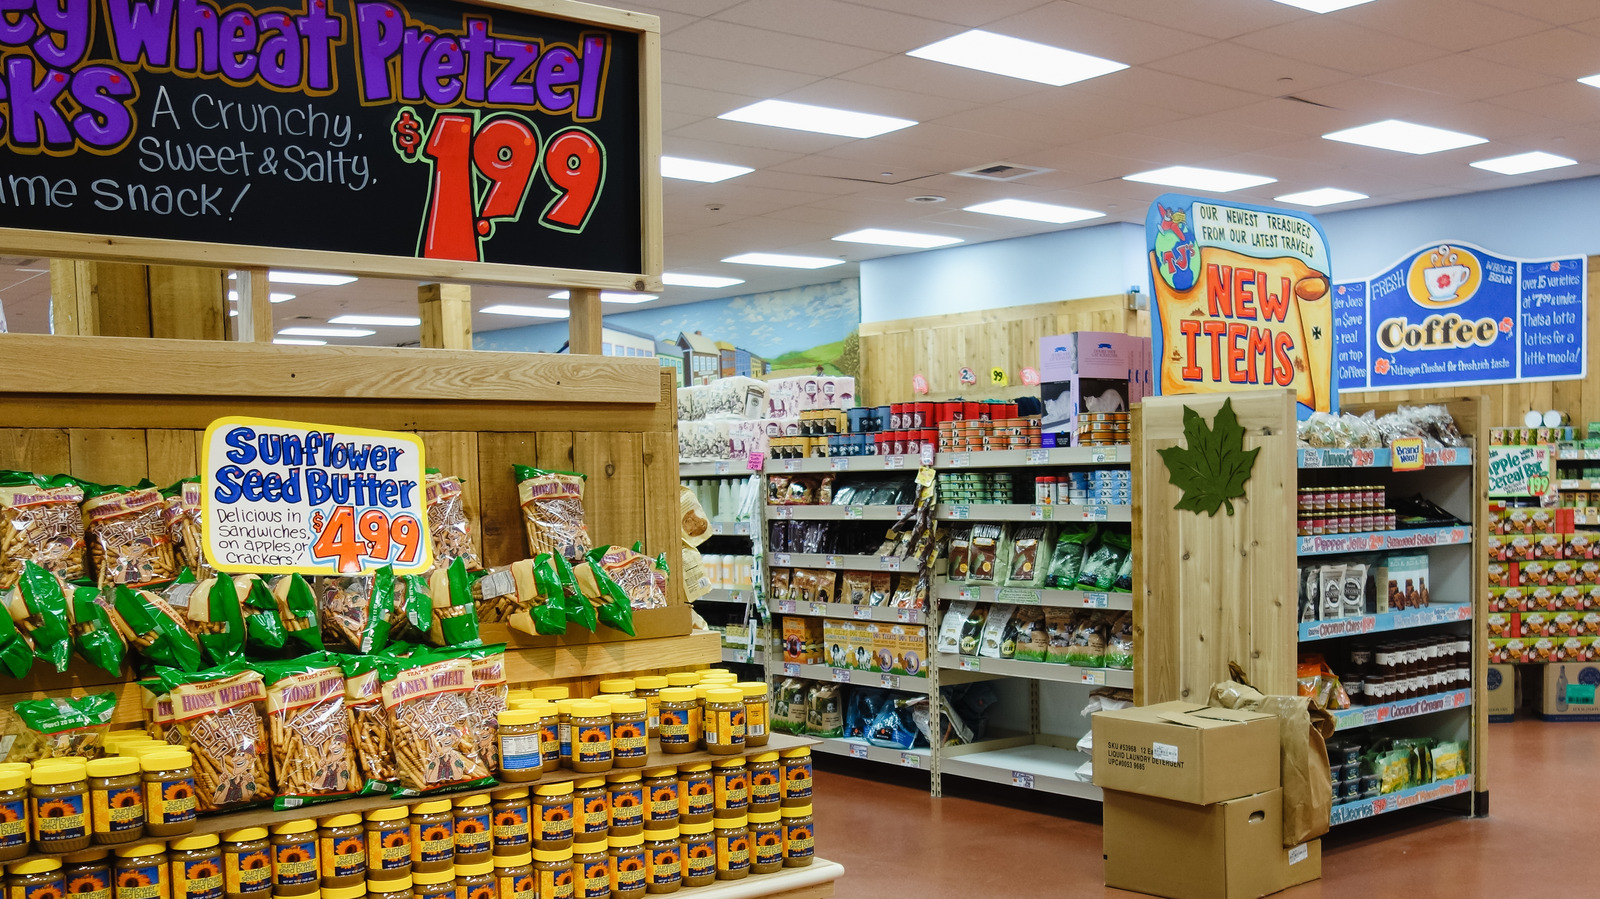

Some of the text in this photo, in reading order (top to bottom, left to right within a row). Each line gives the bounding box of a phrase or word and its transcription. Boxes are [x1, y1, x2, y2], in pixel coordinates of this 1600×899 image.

[107, 0, 342, 90] Wheat
[355, 2, 605, 119] Pretzel
[0, 58, 134, 147] ks
[151, 85, 363, 148] A Crunchy,
[138, 136, 255, 177] Sweet
[283, 145, 378, 192] Salty,
[1200, 206, 1311, 240] OUR NEWEST TREASURES
[1202, 226, 1314, 258] FROM OUR LATEST TRAVELS
[1485, 260, 1515, 275] WHOLE
[1370, 269, 1406, 301] FRESH
[1487, 271, 1513, 285] BEAN
[1522, 279, 1537, 291] over
[1547, 274, 1580, 288] varieties
[1206, 263, 1291, 322] NEW
[1522, 295, 1531, 309] at
[1553, 311, 1576, 325] lotta
[1341, 330, 1358, 344] real
[1379, 316, 1496, 350] Coffee
[1524, 330, 1575, 346] lattes for a
[1179, 319, 1295, 387] ITEMS
[1348, 349, 1363, 362] top
[1524, 347, 1581, 366] little moola!
[225, 426, 405, 472] Sunflower
[1395, 444, 1420, 456] Brand
[1321, 449, 1354, 467] Almonds
[1522, 461, 1543, 478] Bar
[214, 464, 302, 505] Seed
[305, 467, 417, 508] Butter
[1488, 466, 1525, 491] Cereal
[216, 507, 302, 524] Delicious in
[219, 539, 240, 550] on
[1314, 536, 1346, 551] Pepper
[1344, 536, 1368, 551] Jelly
[1386, 534, 1417, 549] Seaweed
[1417, 531, 1437, 546] Salad
[1319, 620, 1346, 637] Coconut
[1346, 619, 1361, 633] Chips
[195, 681, 220, 691] TRADER
[297, 673, 319, 683] TRADER
[392, 676, 429, 700] HONEY
[430, 670, 465, 689] WHEAT
[181, 690, 217, 713] HONEY
[218, 680, 261, 705] WHEAT
[1390, 702, 1420, 719] Coconut
[1420, 698, 1444, 712] Cream
[1107, 741, 1119, 750] SKU
[1140, 746, 1147, 754] 12
[1107, 750, 1126, 759] LIQUID
[1125, 753, 1151, 764] LAUNDRY
[41, 814, 81, 826] sunflower
[59, 820, 84, 830] butter
[1, 825, 25, 836] butter
[280, 859, 315, 870] sunflower
[120, 884, 156, 895] sunflower
